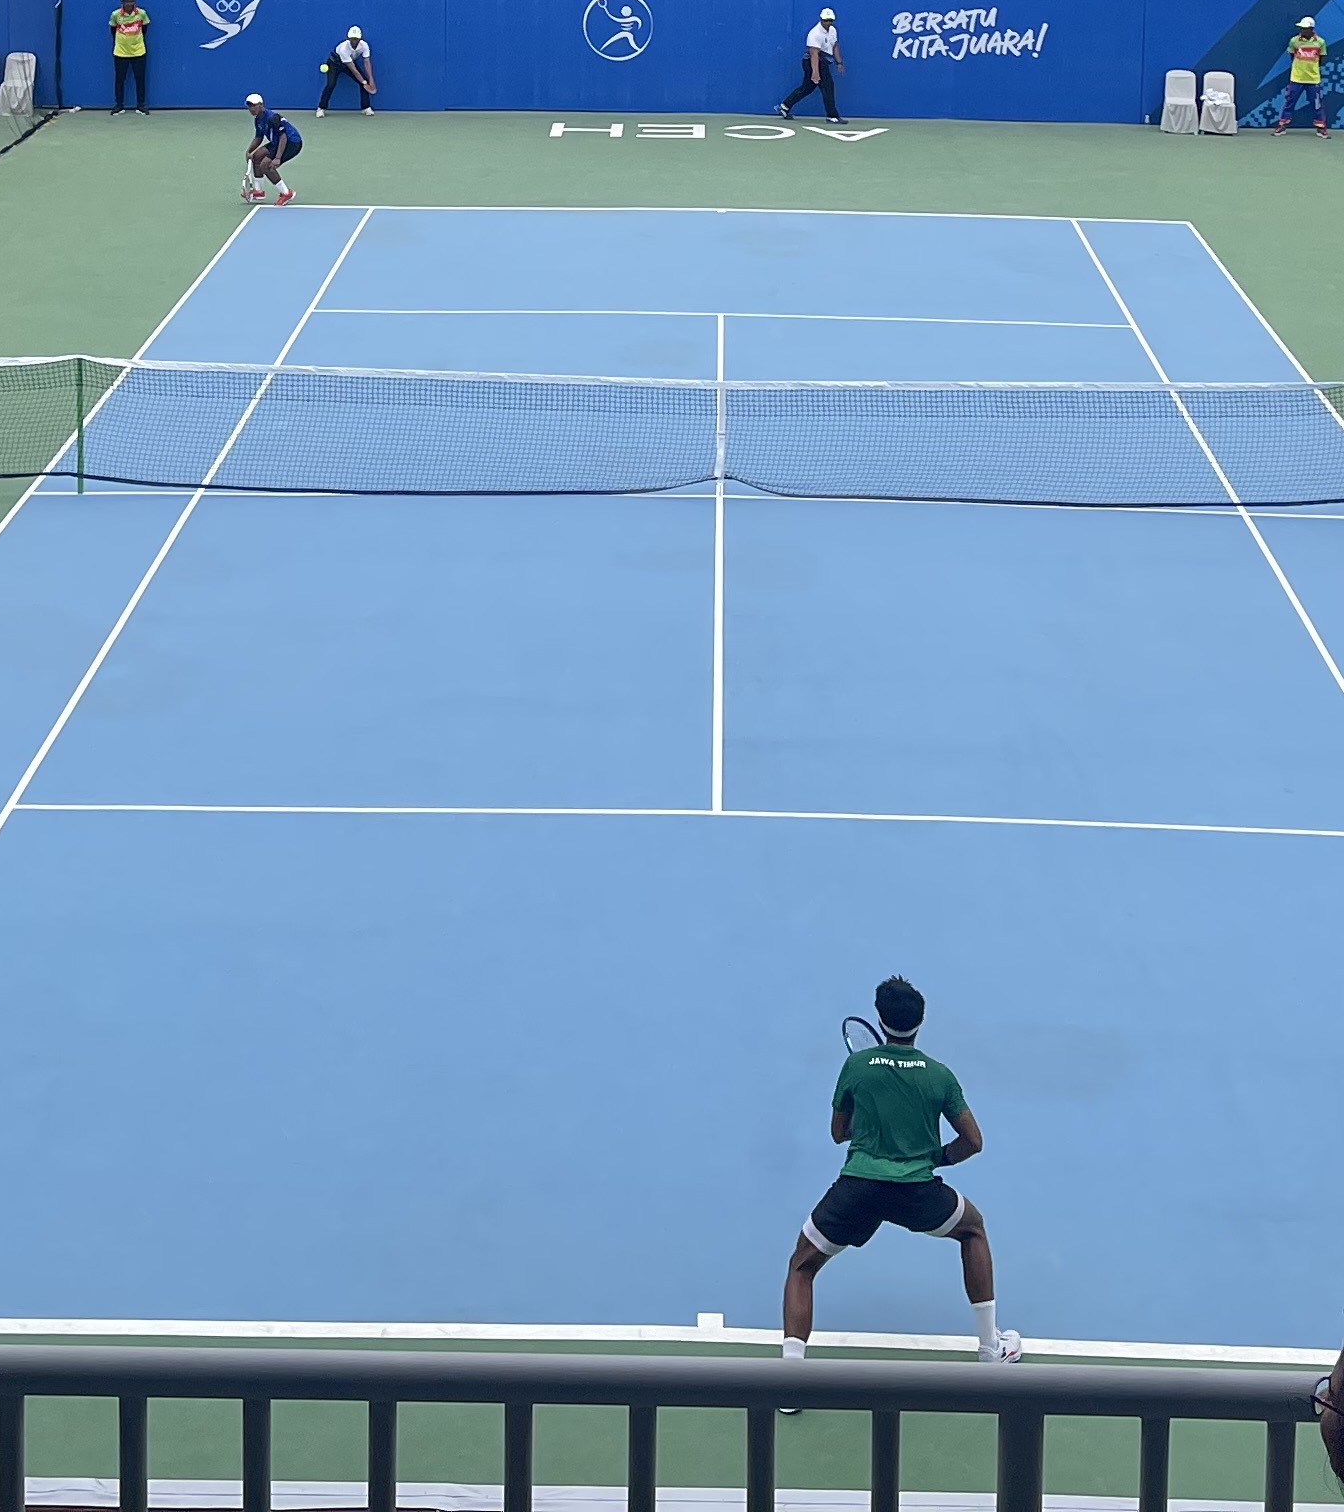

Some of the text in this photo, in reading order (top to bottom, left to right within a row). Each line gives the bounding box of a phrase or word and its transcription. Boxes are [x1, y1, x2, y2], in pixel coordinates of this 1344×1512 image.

[891, 6, 998, 35] BERSATU
[891, 22, 1049, 61] KITA JUARA!
[549, 122, 891, 142] ACEH
[868, 1057, 927, 1069] JAWA TIMUR
